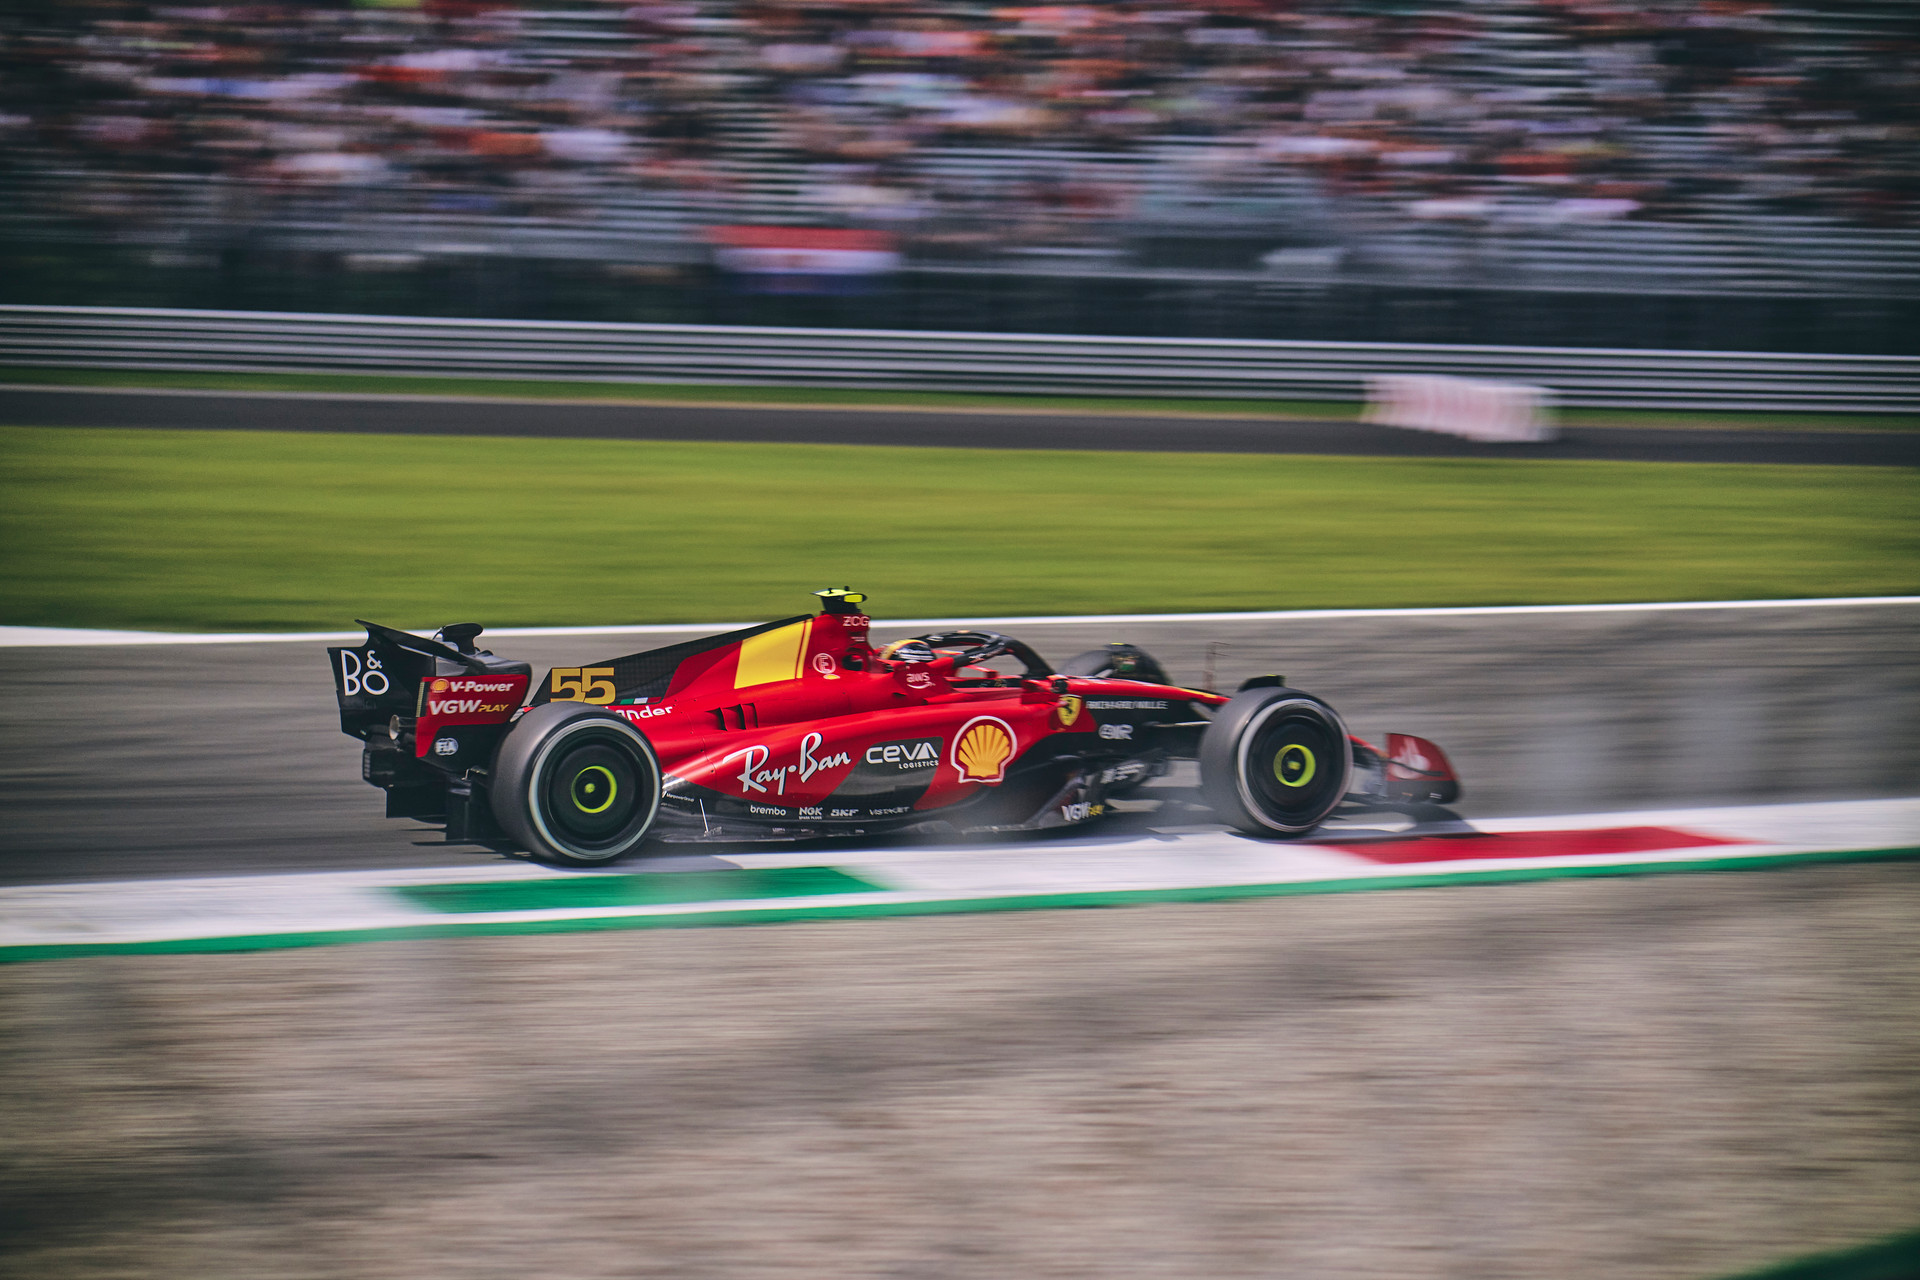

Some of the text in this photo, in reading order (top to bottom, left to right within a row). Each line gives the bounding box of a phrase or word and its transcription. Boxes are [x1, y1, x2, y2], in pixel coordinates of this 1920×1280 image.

[450, 681, 514, 692] V-Power
[550, 667, 616, 705] 55
[429, 699, 482, 715] VGW
[435, 738, 458, 755] FIA
[898, 760, 939, 770] LOGISTICS
[750, 804, 787, 816] brembo
[799, 806, 823, 816] NGK
[830, 808, 859, 817] SKF
